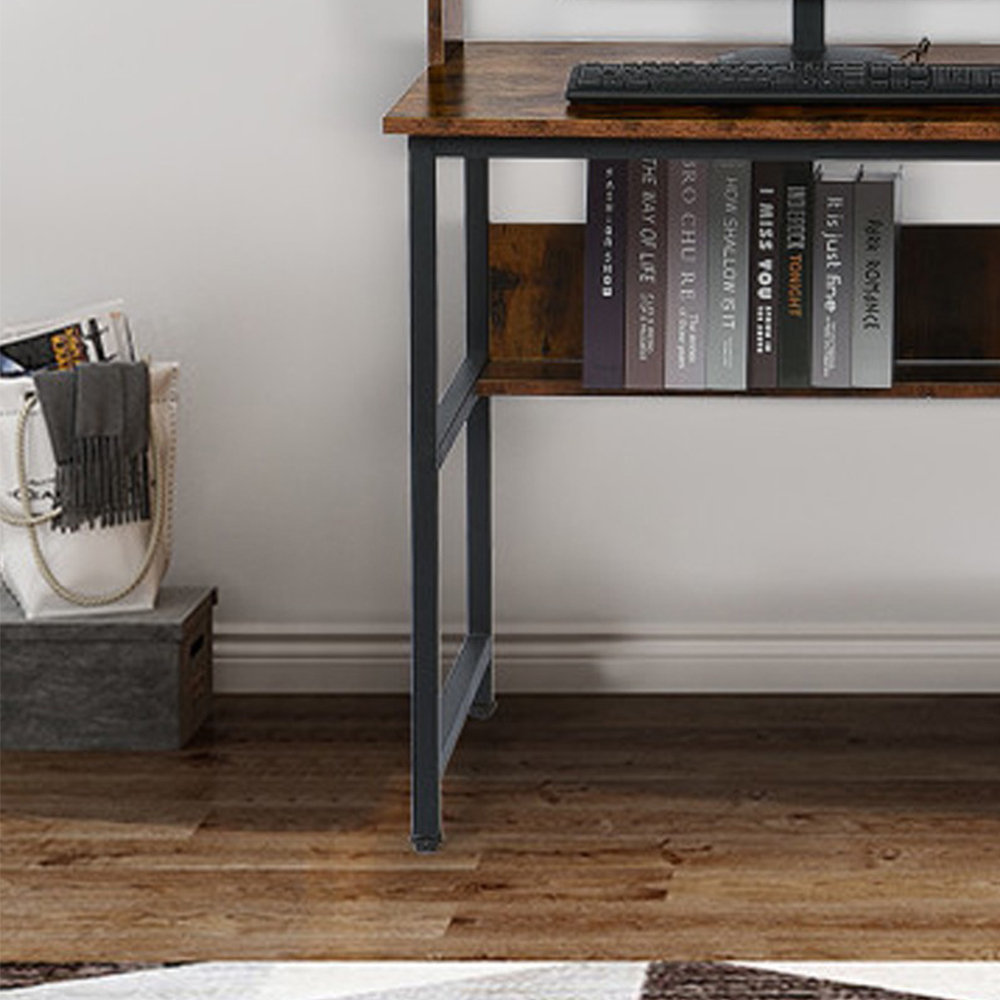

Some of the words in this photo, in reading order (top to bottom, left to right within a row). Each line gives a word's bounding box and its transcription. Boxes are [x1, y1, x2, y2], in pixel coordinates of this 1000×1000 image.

[642, 158, 657, 185] THE
[827, 196, 843, 208] It
[827, 214, 844, 227] is
[640, 228, 657, 249] OF
[759, 203, 775, 250] MISS
[639, 253, 656, 283] LIFE
[722, 217, 738, 293] SHALLOW
[821, 231, 843, 268] just
[757, 259, 773, 300] YOU
[788, 254, 803, 316] TONIGHT
[824, 273, 841, 313] fine
[863, 259, 881, 330] ROMANCE
[722, 314, 736, 330] IT
